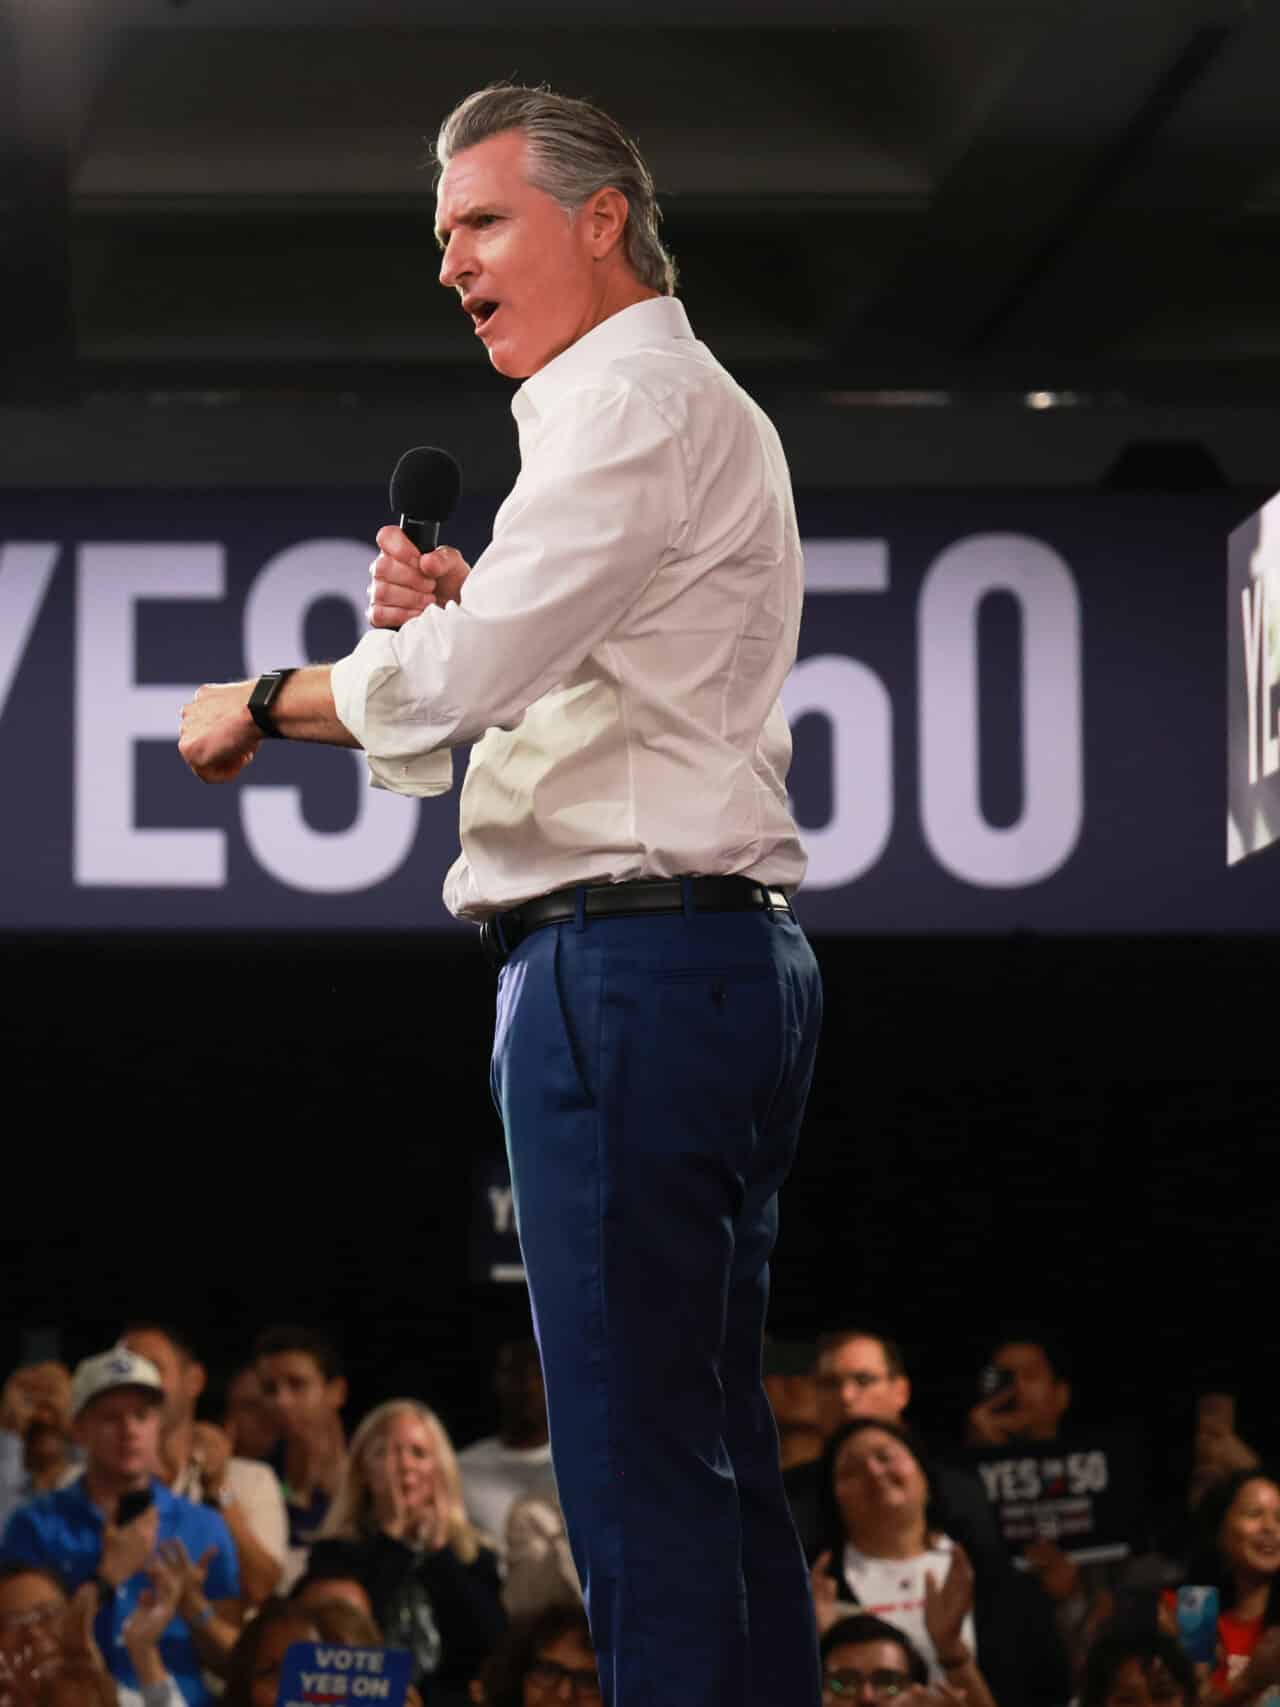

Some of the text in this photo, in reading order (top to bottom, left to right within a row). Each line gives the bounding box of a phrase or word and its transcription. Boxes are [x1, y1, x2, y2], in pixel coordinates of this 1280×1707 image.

[782, 532, 1084, 890] 50
[978, 1458, 1041, 1501] YES
[315, 1648, 384, 1672] VOTE
[300, 1672, 390, 1698] YES ON
